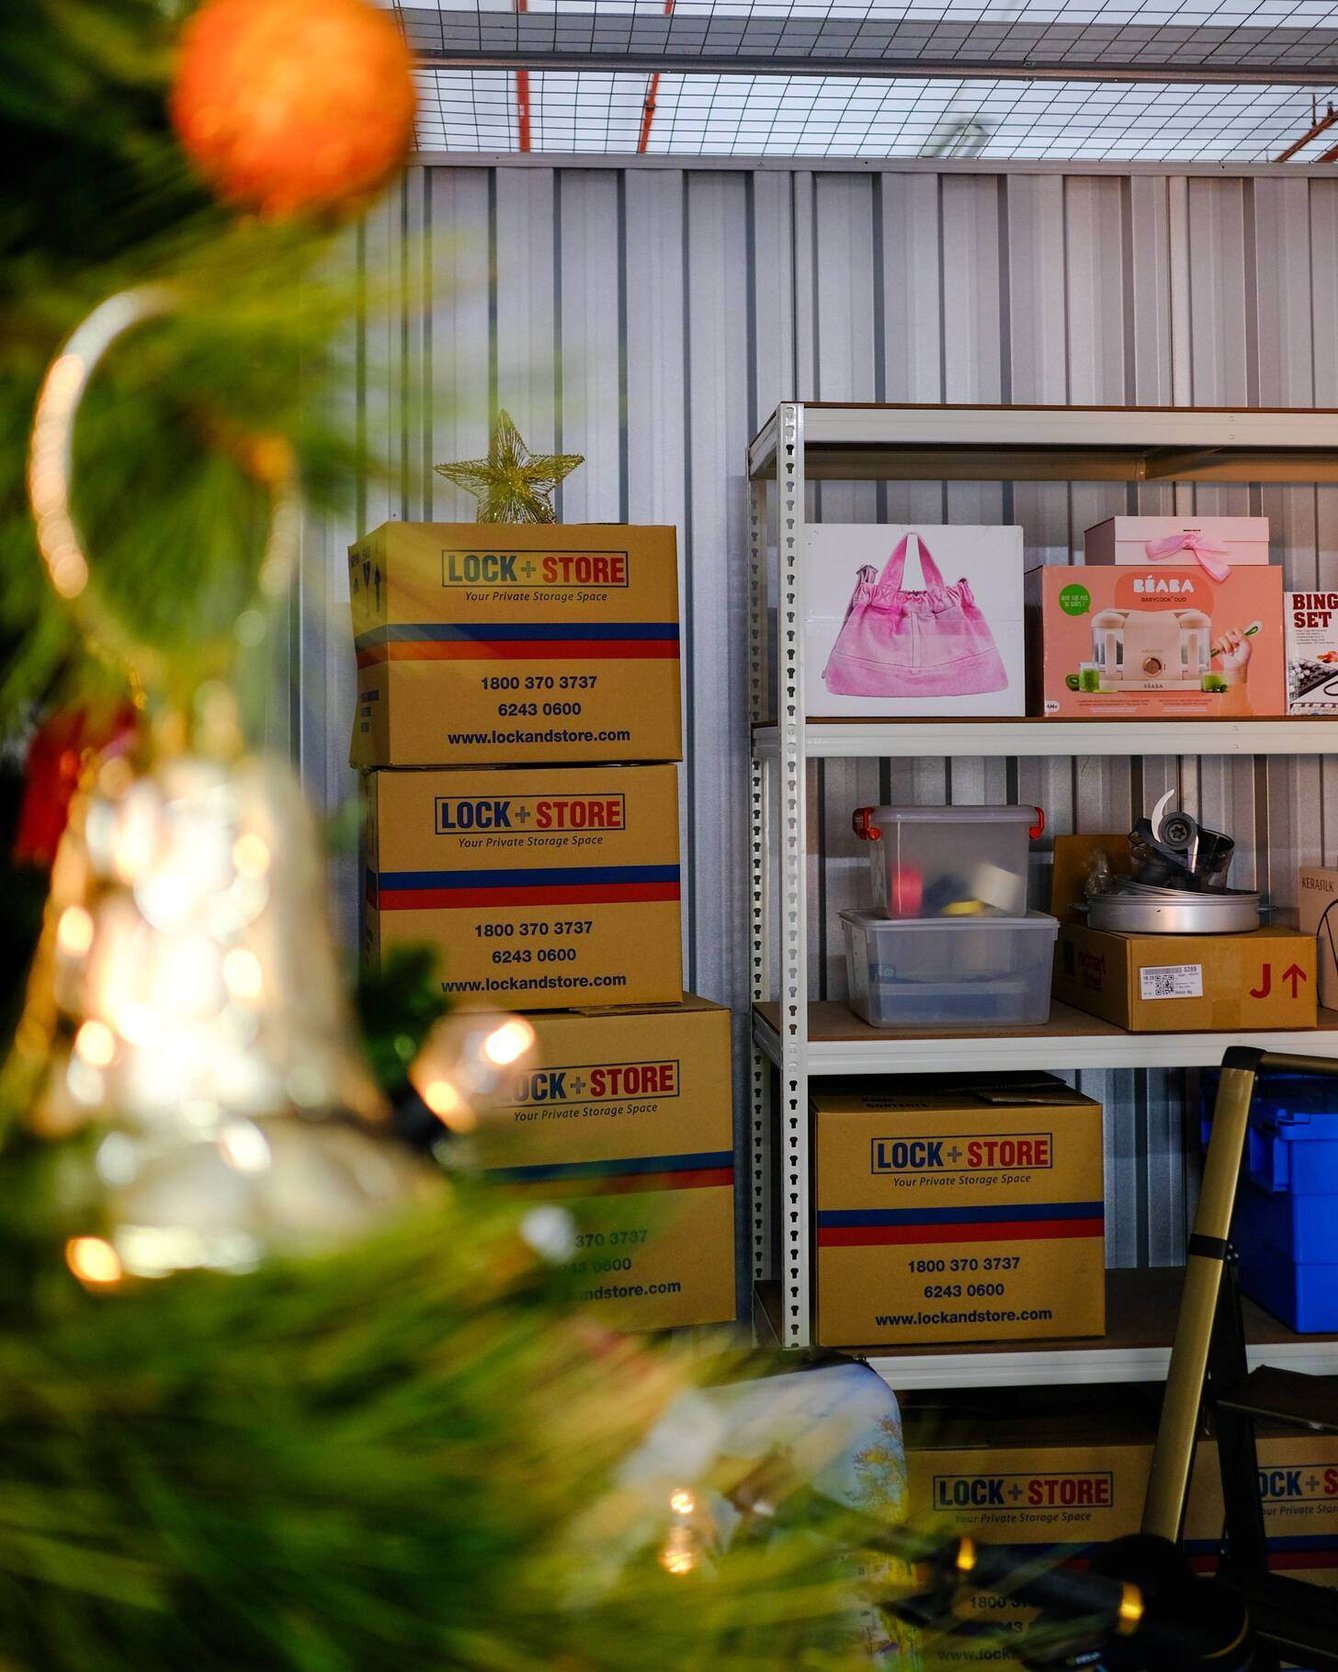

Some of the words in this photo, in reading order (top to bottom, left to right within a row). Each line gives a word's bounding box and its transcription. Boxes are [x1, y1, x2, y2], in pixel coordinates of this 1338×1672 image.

[448, 554, 517, 582] LOCK
[542, 556, 625, 583] STORE
[1133, 574, 1194, 593] BÉABA
[465, 591, 489, 601] Your
[492, 591, 530, 601] Private
[533, 591, 574, 603] Storage
[576, 591, 607, 603] Space
[1293, 612, 1332, 628] SET
[482, 677, 519, 690] 1800
[525, 677, 554, 690] 370
[559, 676, 598, 689] 3737
[498, 703, 537, 716] 6243
[543, 702, 582, 716] 0600
[448, 730, 630, 744] www.lockandstore.com
[441, 801, 511, 829] LOCK
[536, 800, 621, 828] STORE
[459, 837, 483, 849] Your
[485, 837, 524, 847] Private
[527, 836, 569, 848] Storage
[571, 835, 603, 847] Space
[1301, 877, 1335, 893] KERASILK
[475, 924, 514, 937] 1800
[519, 923, 549, 936] 370
[554, 921, 593, 935] 3737
[492, 950, 532, 964] 6243
[537, 948, 576, 962] 0600
[441, 974, 626, 992] www.lockandstore.com
[1249, 963, 1271, 999] J
[509, 1072, 566, 1102] OCK
[589, 1065, 675, 1098] STORE
[514, 1111, 539, 1122] Your
[541, 1108, 580, 1120] Private
[582, 1105, 624, 1119] Storage
[626, 1103, 658, 1116] Space
[877, 1142, 944, 1168] LOCK
[967, 1140, 1048, 1167] STORE
[893, 1177, 917, 1187] Your
[920, 1176, 956, 1186] Private
[958, 1175, 999, 1187] Storage
[1001, 1174, 1032, 1185] Space
[574, 1234, 605, 1248] 370
[610, 1229, 649, 1246] 3737
[908, 1260, 945, 1273] 1800
[950, 1259, 978, 1272] 370
[983, 1257, 1020, 1271] 3737
[924, 1285, 962, 1298] 6243
[967, 1283, 1005, 1297] 0600
[875, 1309, 1052, 1326] www.lockandstore.com
[1256, 1471, 1303, 1497] OCK
[939, 1479, 1005, 1506] LOCK
[1028, 1479, 1109, 1505] STORE
[955, 1514, 978, 1524] Your
[980, 1514, 1017, 1523] Private
[1019, 1513, 1059, 1524] Storage
[1061, 1511, 1091, 1523] Space
[1280, 1506, 1315, 1515] Private
